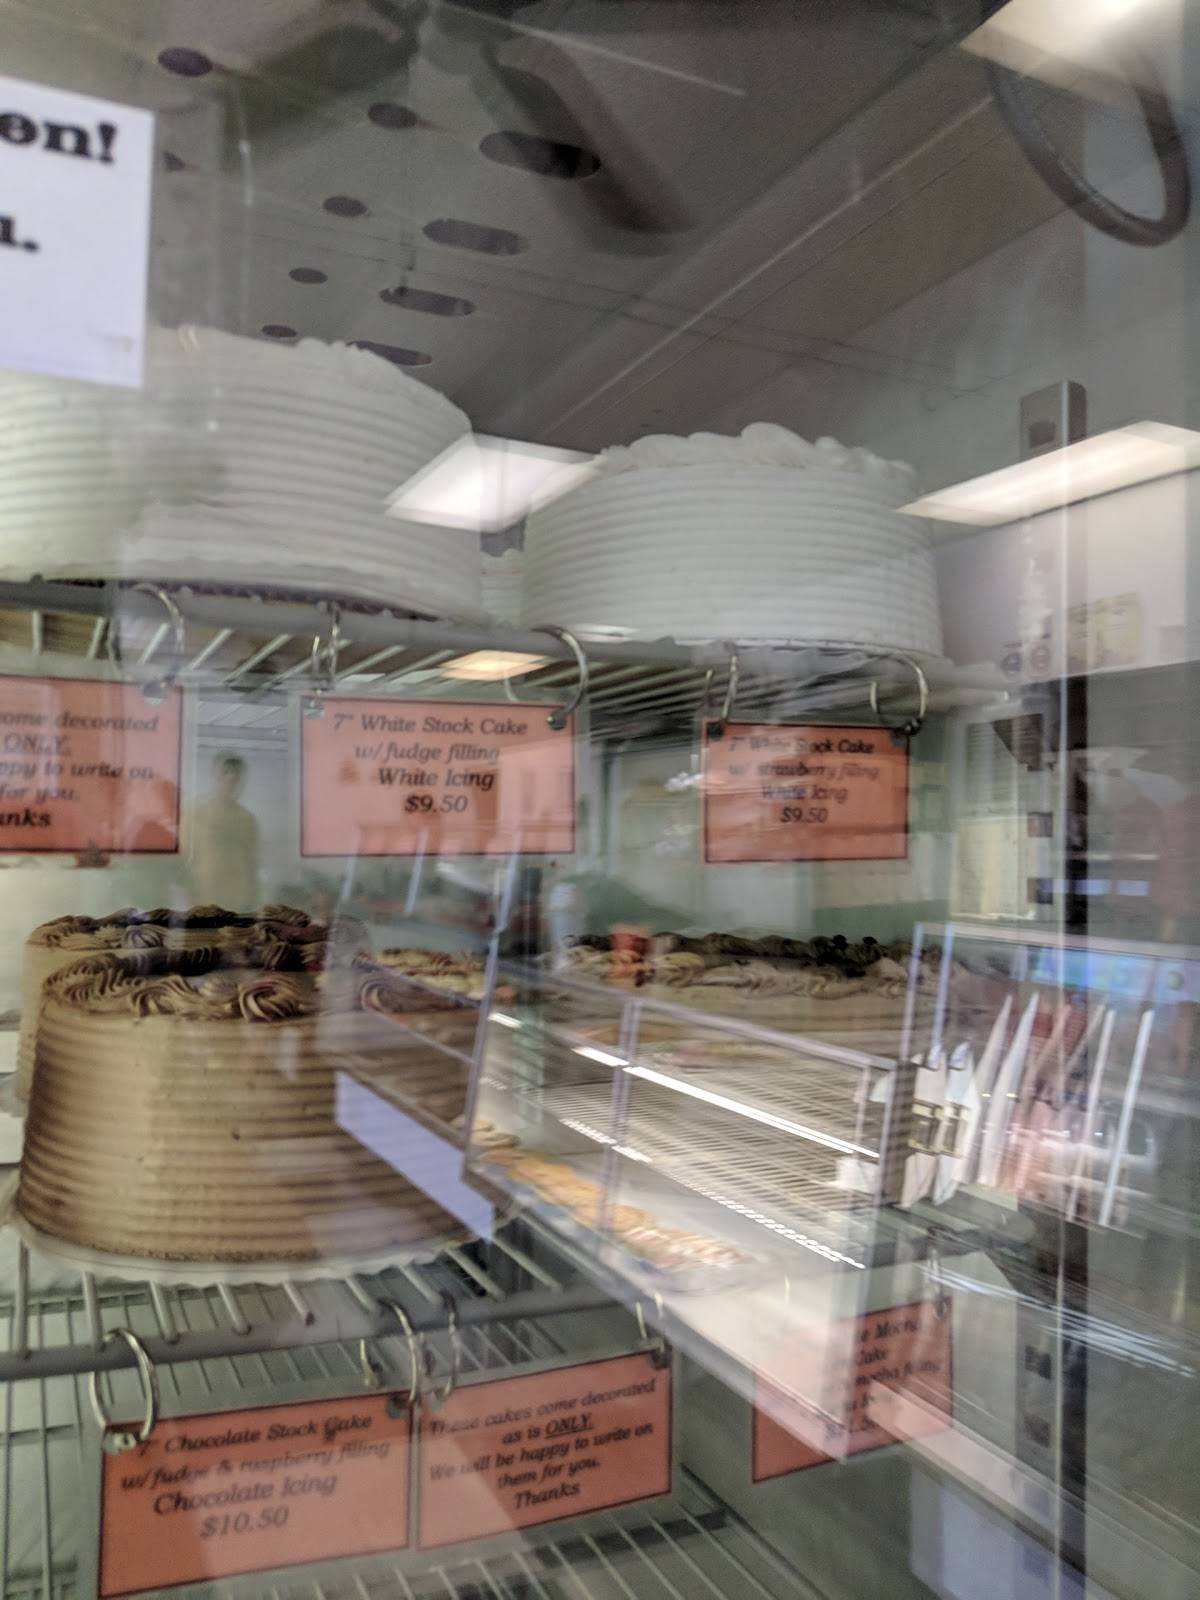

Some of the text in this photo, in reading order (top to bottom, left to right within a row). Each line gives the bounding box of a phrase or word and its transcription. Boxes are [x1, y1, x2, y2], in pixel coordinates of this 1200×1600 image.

[361, 714, 417, 732] White
[422, 715, 473, 734] Stock
[480, 717, 529, 736] Cake
[446, 745, 500, 765] filling
[379, 768, 496, 791] White Icing
[404, 794, 468, 814] $9.50
[780, 807, 829, 824] $9.50
[485, 1406, 533, 1427] cakes
[537, 1397, 577, 1415] come
[580, 1379, 656, 1407] decorated
[164, 1428, 260, 1452] Chocolate
[267, 1415, 318, 1441] Stock
[496, 1451, 514, 1467] be
[519, 1440, 570, 1463] happy
[574, 1436, 590, 1451] to
[593, 1427, 631, 1446] write
[634, 1421, 653, 1436] on
[502, 1429, 522, 1445] as
[528, 1425, 541, 1439] is
[239, 1448, 333, 1474] raspberry
[497, 1468, 537, 1488] them
[539, 1462, 562, 1482] for
[153, 1473, 338, 1515] Chocolate Icing
[514, 1480, 581, 1509] Thanks
[200, 1506, 290, 1537] $10.50
